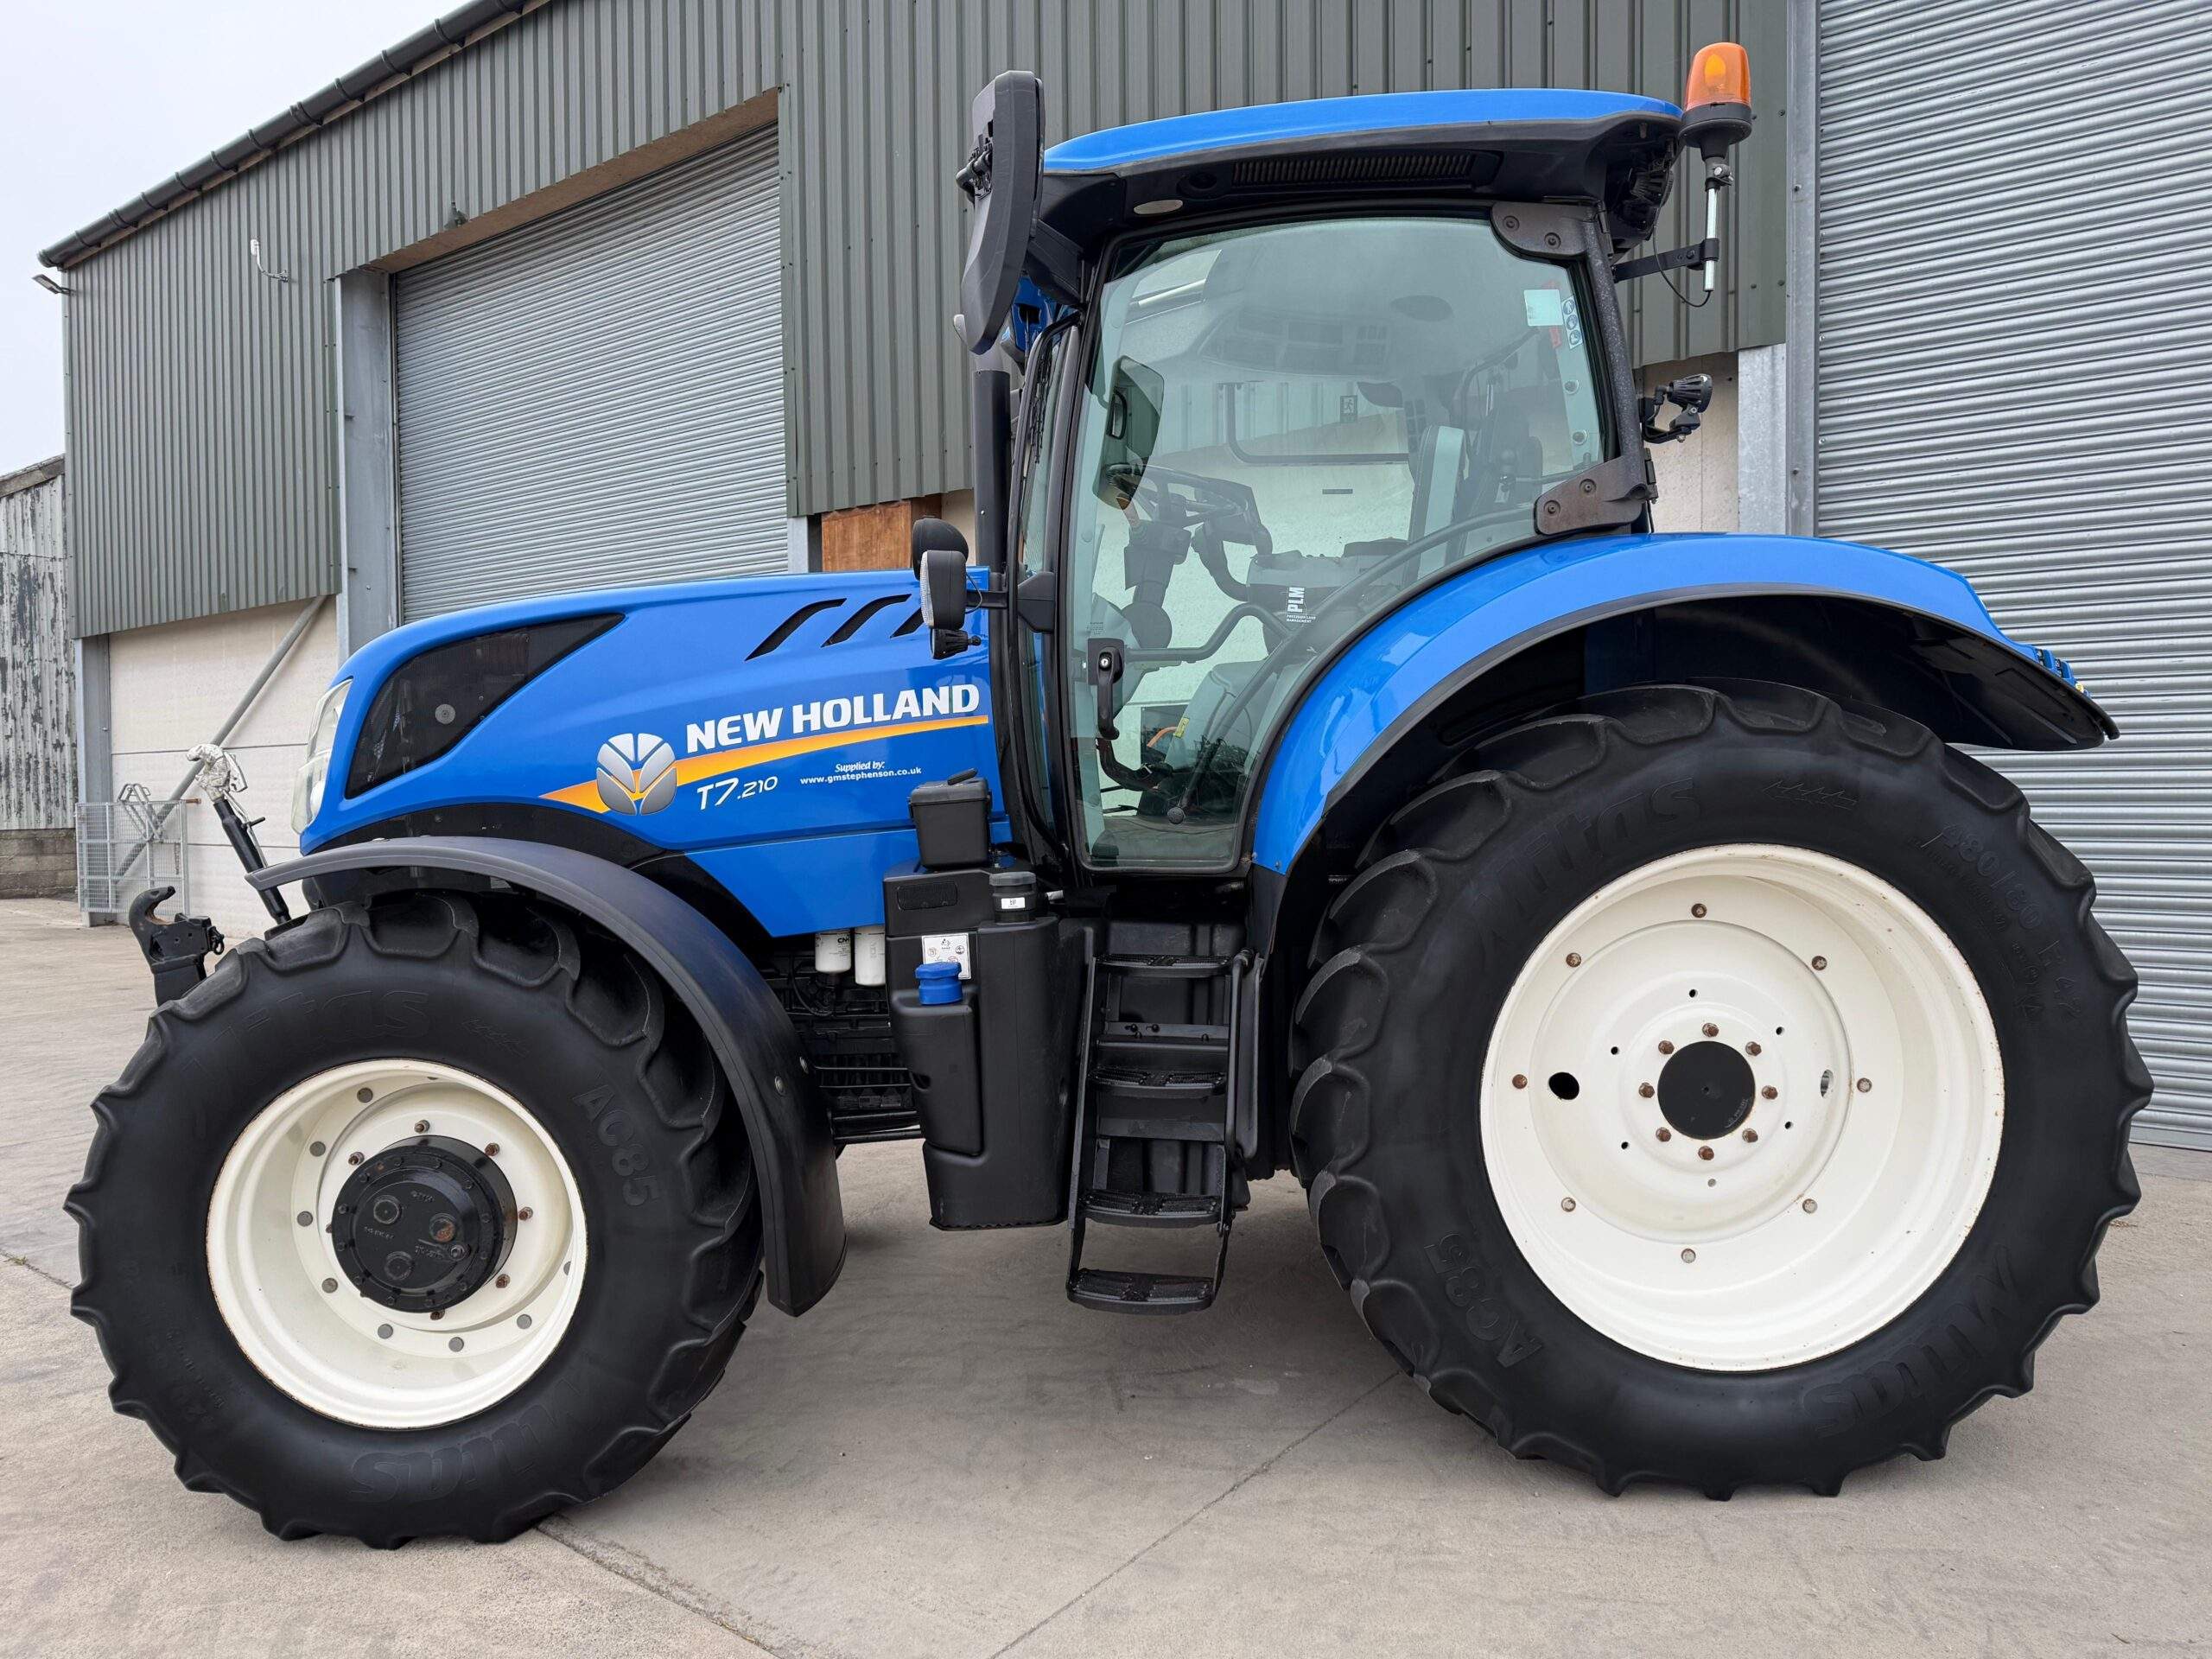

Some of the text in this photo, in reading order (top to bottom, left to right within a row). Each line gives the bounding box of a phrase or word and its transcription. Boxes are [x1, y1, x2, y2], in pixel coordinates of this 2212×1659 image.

[1287, 588, 1305, 613] PLM
[687, 683, 980, 753] NEW HOLLAND
[800, 766, 922, 785] www.gmstephenson.co.uk
[835, 760, 886, 773] Supplied by:
[696, 777, 778, 810] T7.210
[571, 1084, 661, 1206] AC85
[1423, 1233, 1543, 1368] AC85
